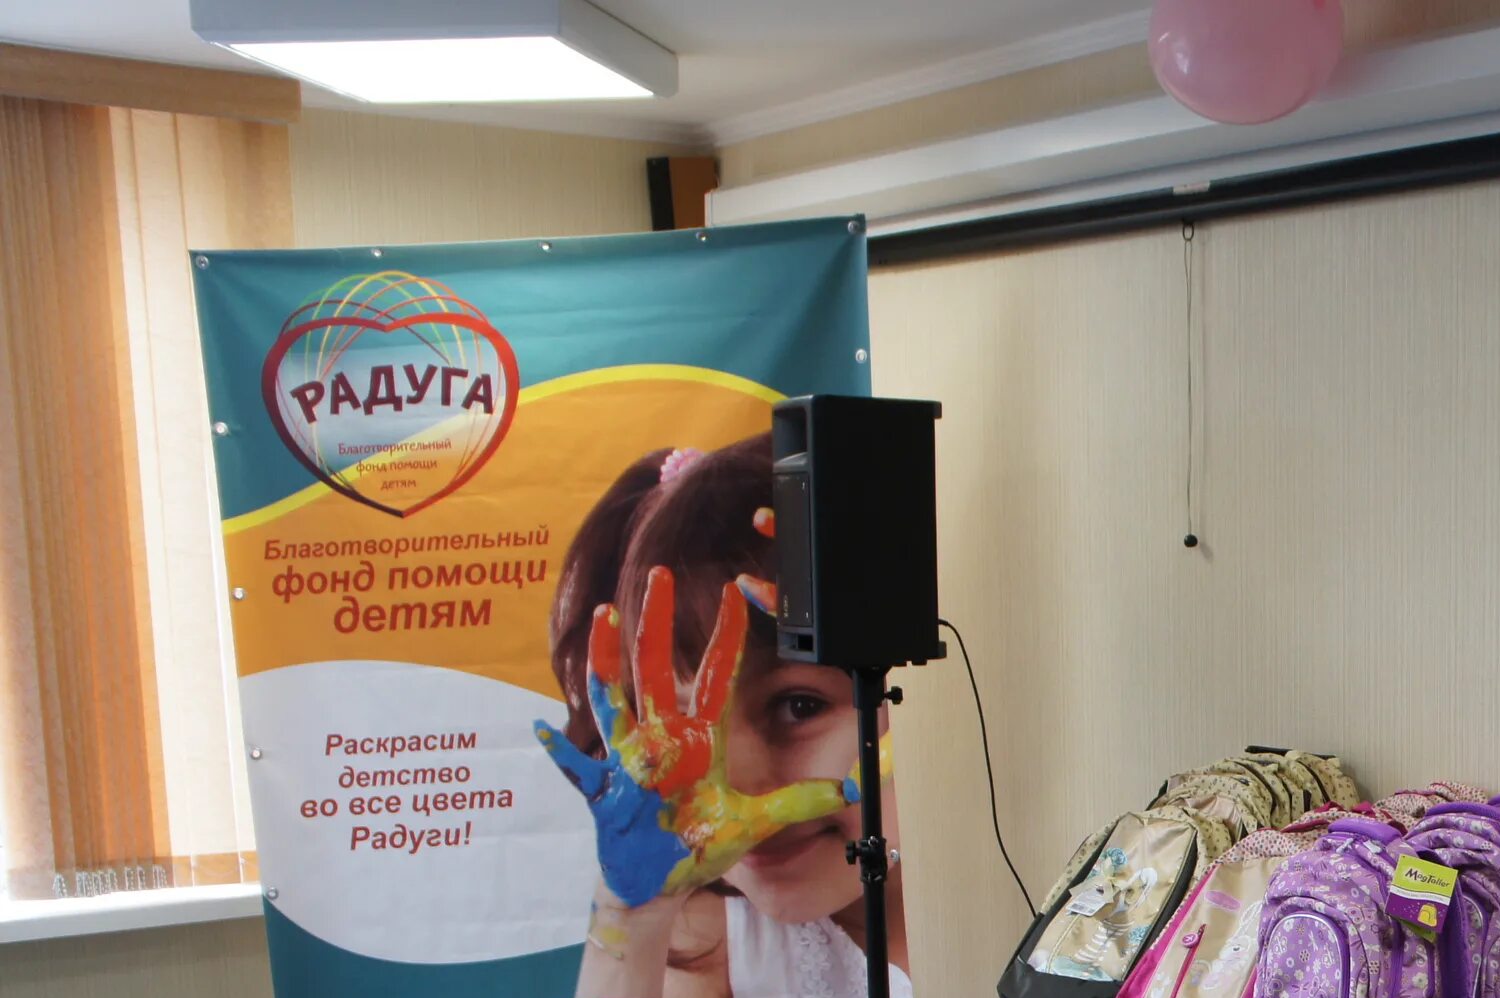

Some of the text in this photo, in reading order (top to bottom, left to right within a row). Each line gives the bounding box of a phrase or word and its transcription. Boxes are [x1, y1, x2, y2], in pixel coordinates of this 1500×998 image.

[290, 364, 494, 424] РАДУГА
[338, 438, 452, 455] Благотворительный
[356, 459, 437, 476] фонд помощи
[380, 479, 417, 490] детям
[264, 524, 551, 561] Благотворительный
[271, 556, 547, 603] фонд помощи
[332, 597, 493, 635] детям
[324, 730, 478, 758] Раскрасим
[337, 763, 472, 789] детство
[299, 787, 514, 819] во все цвета
[349, 822, 473, 853] Радуги!
